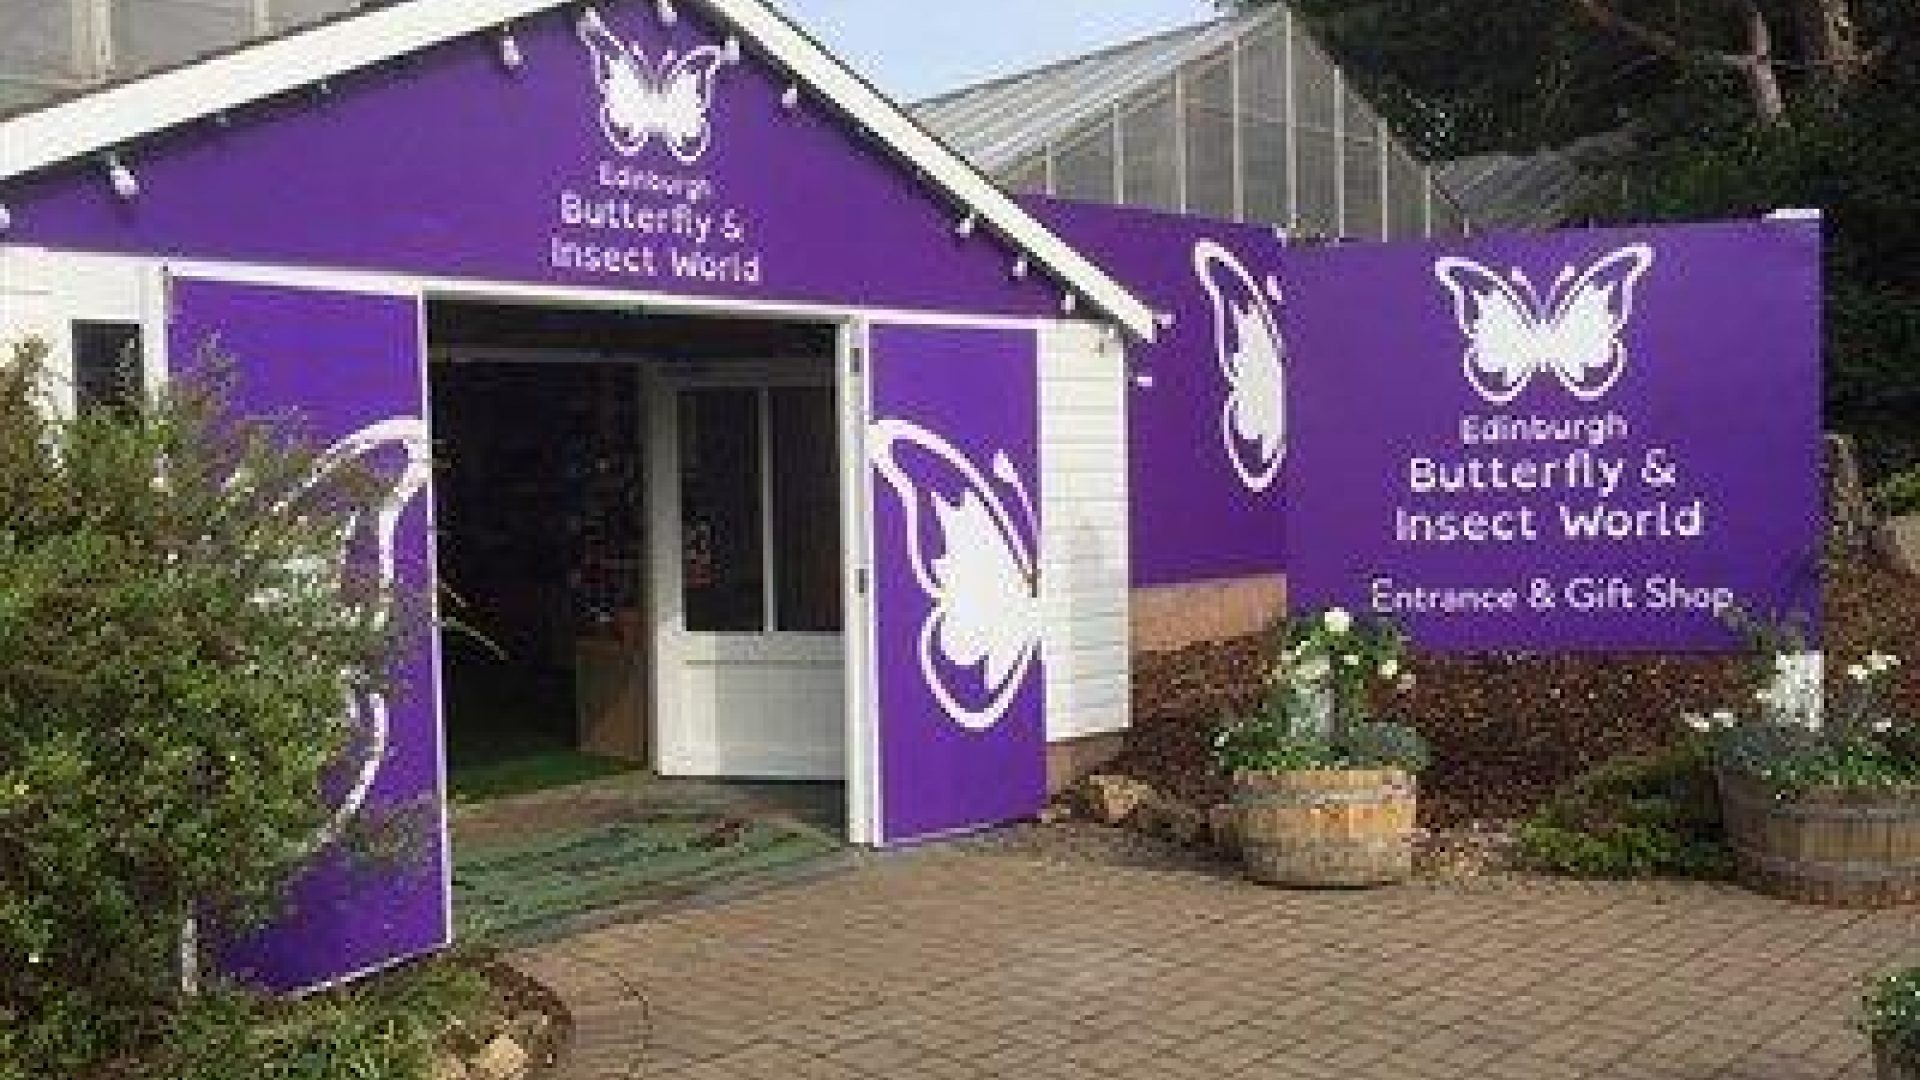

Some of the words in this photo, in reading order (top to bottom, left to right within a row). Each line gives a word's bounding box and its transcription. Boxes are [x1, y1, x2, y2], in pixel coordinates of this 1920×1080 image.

[560, 193, 712, 243] Butterfly
[550, 237, 655, 277] Insect
[671, 247, 761, 284] World
[1460, 411, 1628, 444] Edinburgh
[1409, 448, 1624, 497] Butterfly
[1641, 448, 1677, 484] &
[1396, 506, 1538, 541] Insect
[1559, 501, 1704, 537] World
[1371, 577, 1518, 613] Entrance
[1529, 577, 1557, 609] &
[1564, 577, 1635, 609] Gift
[1645, 577, 1735, 618] Shop
